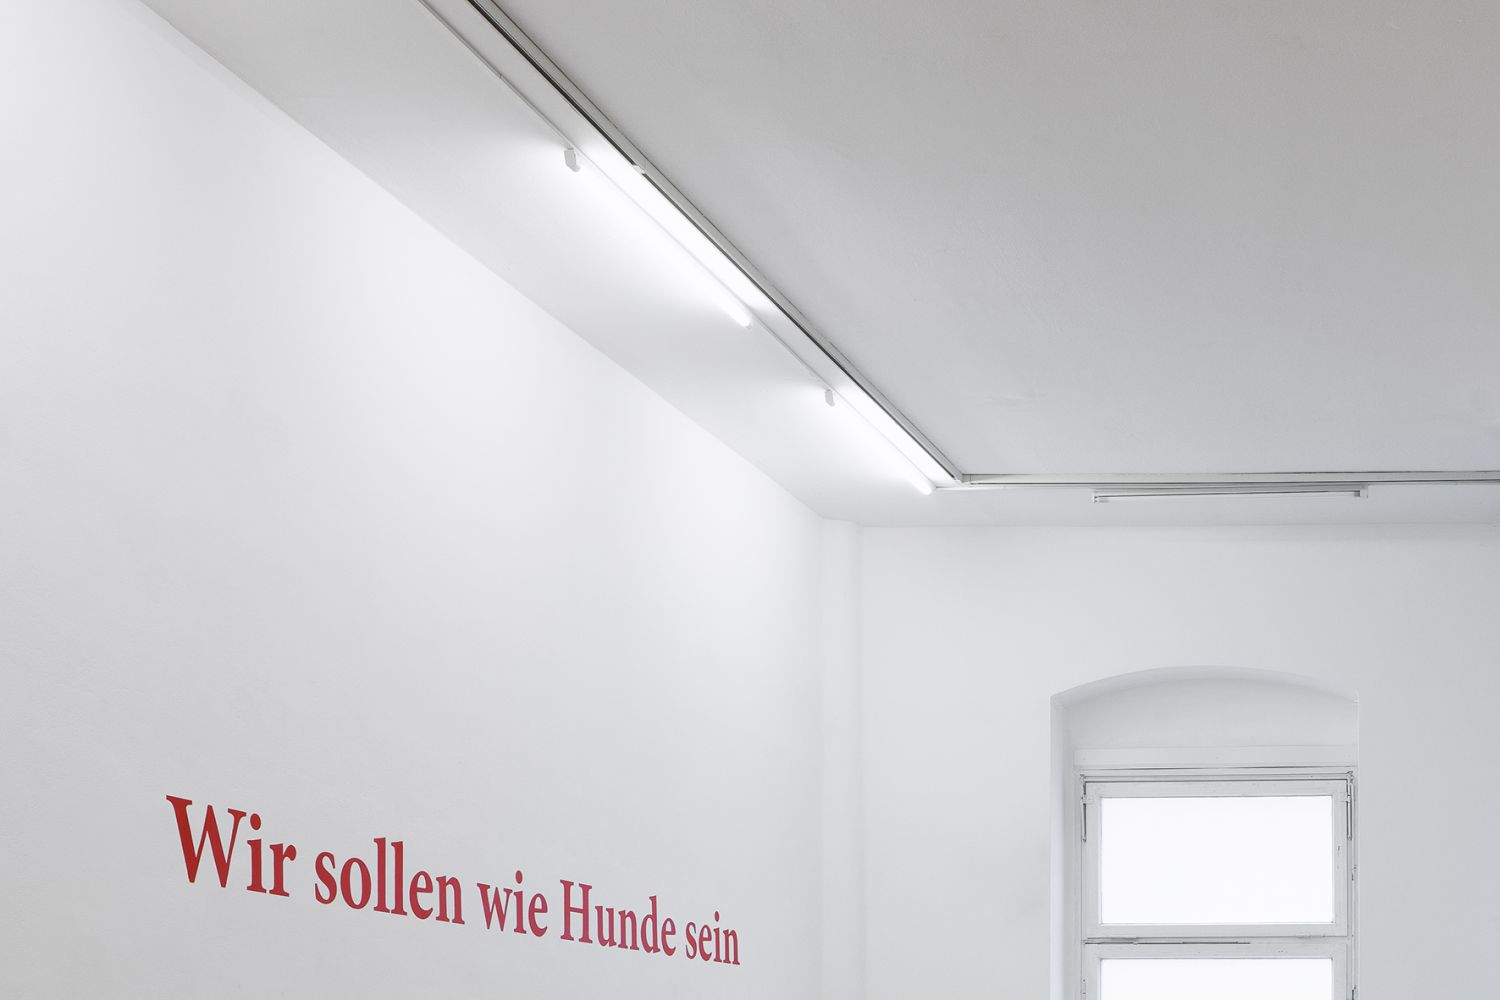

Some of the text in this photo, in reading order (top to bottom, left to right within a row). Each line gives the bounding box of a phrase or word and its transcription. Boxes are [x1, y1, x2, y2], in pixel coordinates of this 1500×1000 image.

[166, 795, 741, 966] Wir sollen wie Hunde sein
